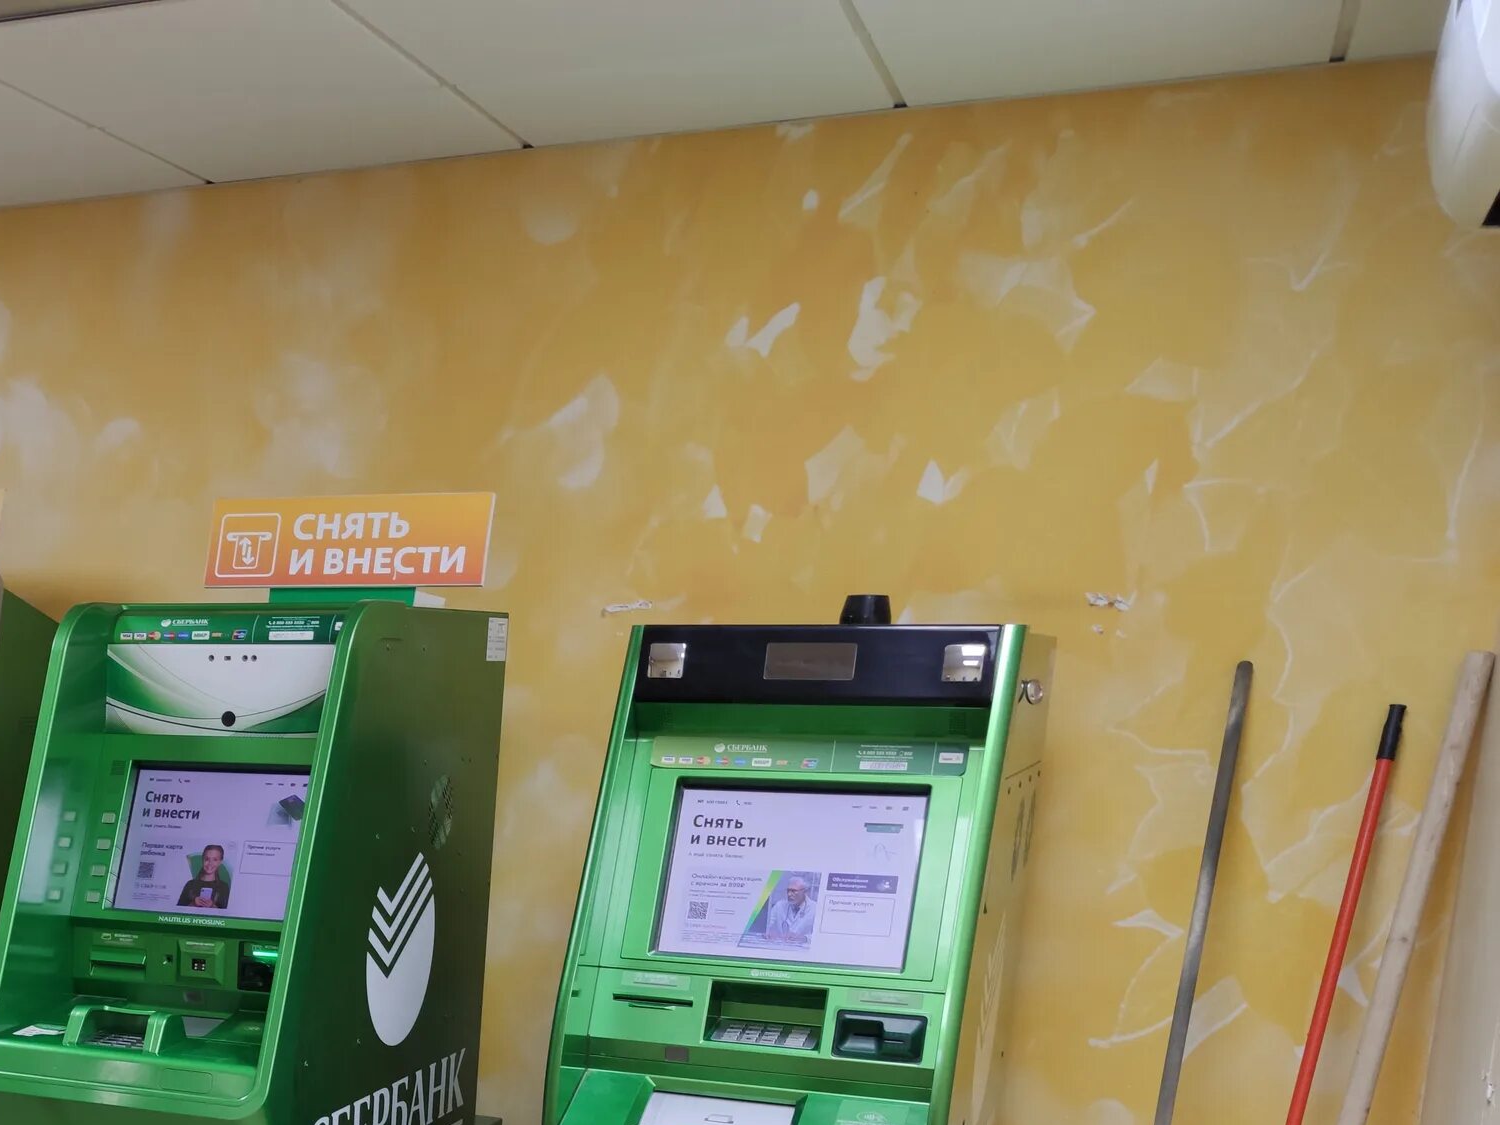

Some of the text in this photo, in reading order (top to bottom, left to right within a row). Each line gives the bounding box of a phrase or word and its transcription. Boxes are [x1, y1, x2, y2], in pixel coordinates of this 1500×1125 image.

[293, 511, 410, 540] СНЯТЬ
[288, 546, 466, 575] И ВНЕСТИ
[726, 743, 768, 751] СБЕРБАНК
[145, 791, 184, 804] Снять
[142, 808, 200, 820] и внести
[693, 814, 744, 829] Снять
[690, 834, 767, 848] и внести
[158, 915, 226, 926] NAUTILUS HYOSUNG
